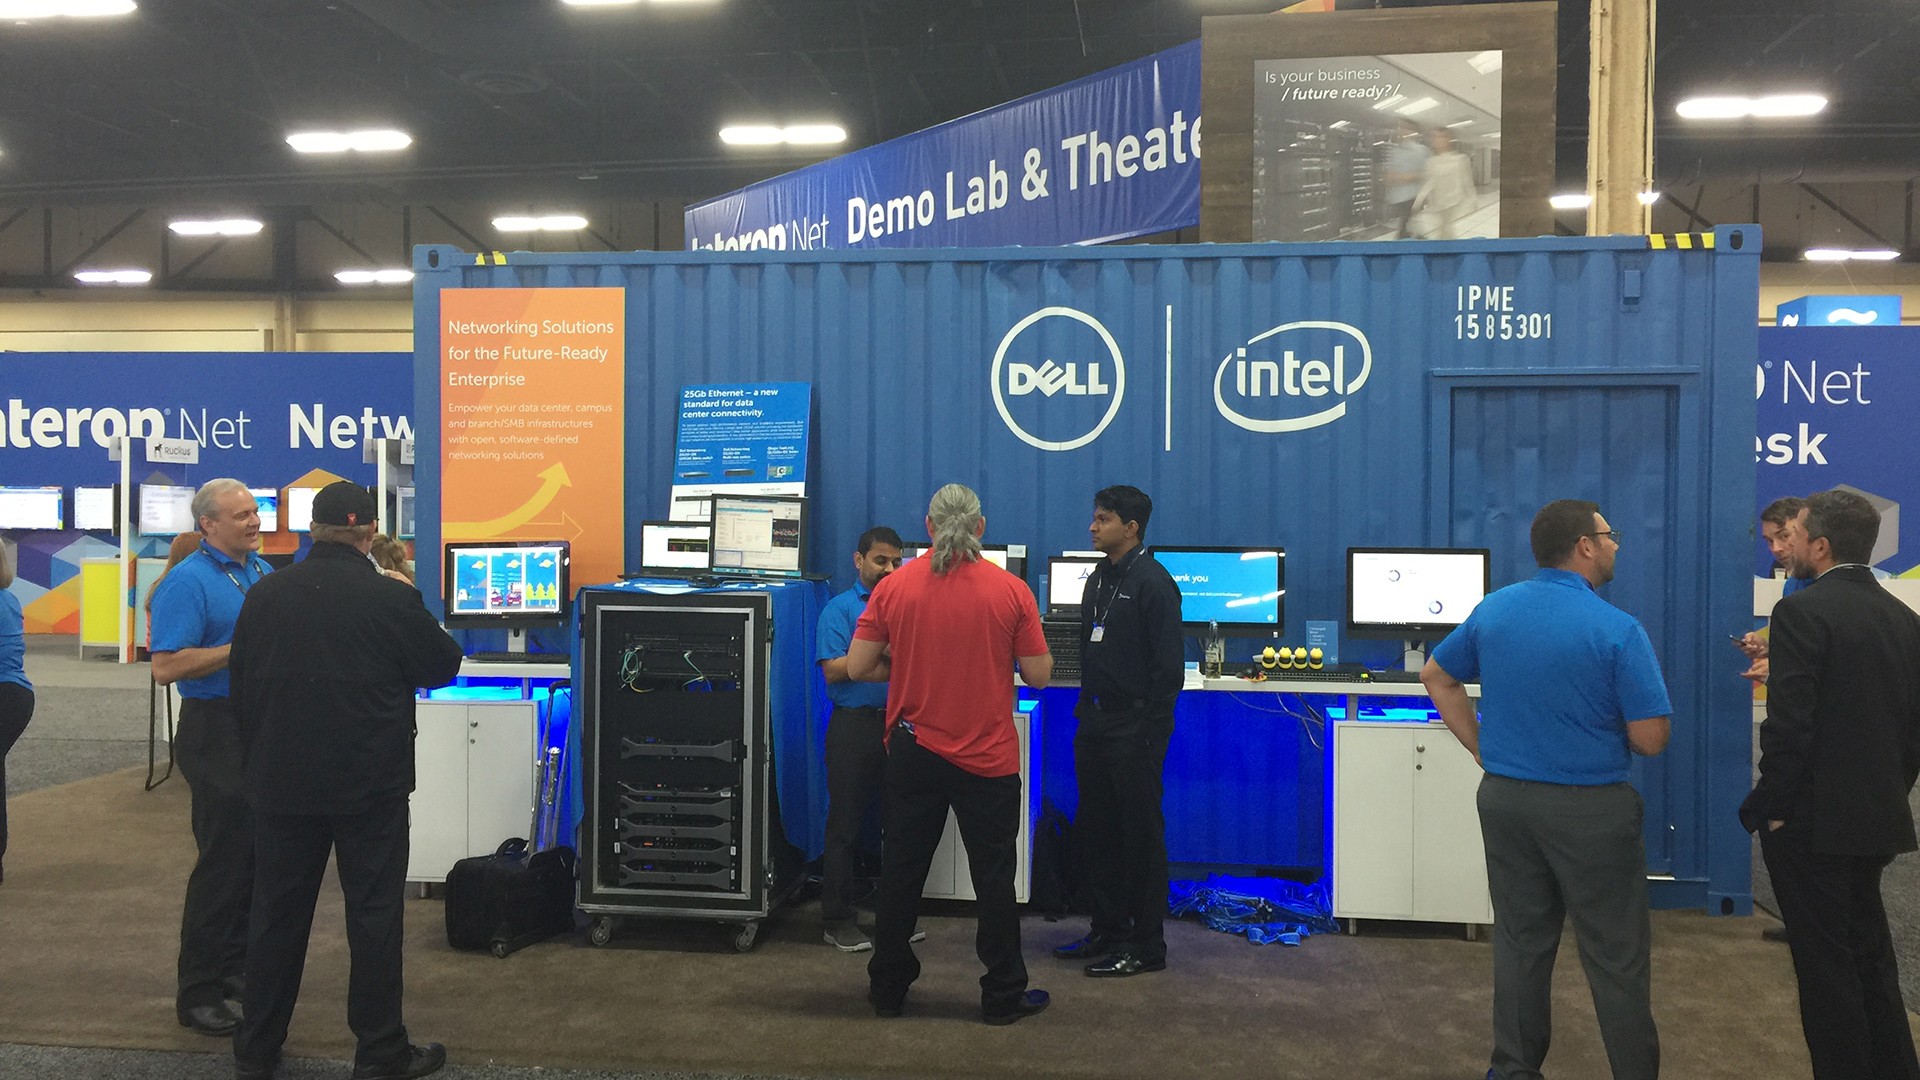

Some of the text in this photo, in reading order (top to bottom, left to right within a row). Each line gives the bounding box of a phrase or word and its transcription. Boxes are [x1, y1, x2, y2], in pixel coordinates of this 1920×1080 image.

[1265, 68, 1381, 86] Is your business
[1292, 87, 1338, 100] future
[692, 223, 787, 251] terop
[792, 213, 829, 251] Net
[847, 190, 935, 245] Demo
[946, 159, 1008, 221] Lab
[1021, 147, 1049, 202] &
[1457, 285, 1515, 312] IPME
[448, 320, 614, 338] Networking Solutions
[1454, 313, 1552, 340] 1585301
[448, 346, 608, 363] for the Future-Ready
[1008, 359, 1109, 398] DELL
[1236, 345, 1345, 397] intel
[448, 372, 526, 389] Enterprise
[1783, 360, 1872, 405] Net
[684, 390, 707, 398] 25Gb
[708, 389, 744, 397] Ethernet
[448, 403, 613, 414] Empower your data center, campus
[711, 409, 764, 418] connectivity.
[0, 398, 166, 449] terop
[179, 408, 252, 449] Net
[448, 418, 594, 429] and branch/SMB infrastructures
[448, 436, 468, 445] with
[499, 434, 579, 445] software-defined
[448, 451, 545, 462] networking solutions
[1172, 573, 1209, 584] ank you
